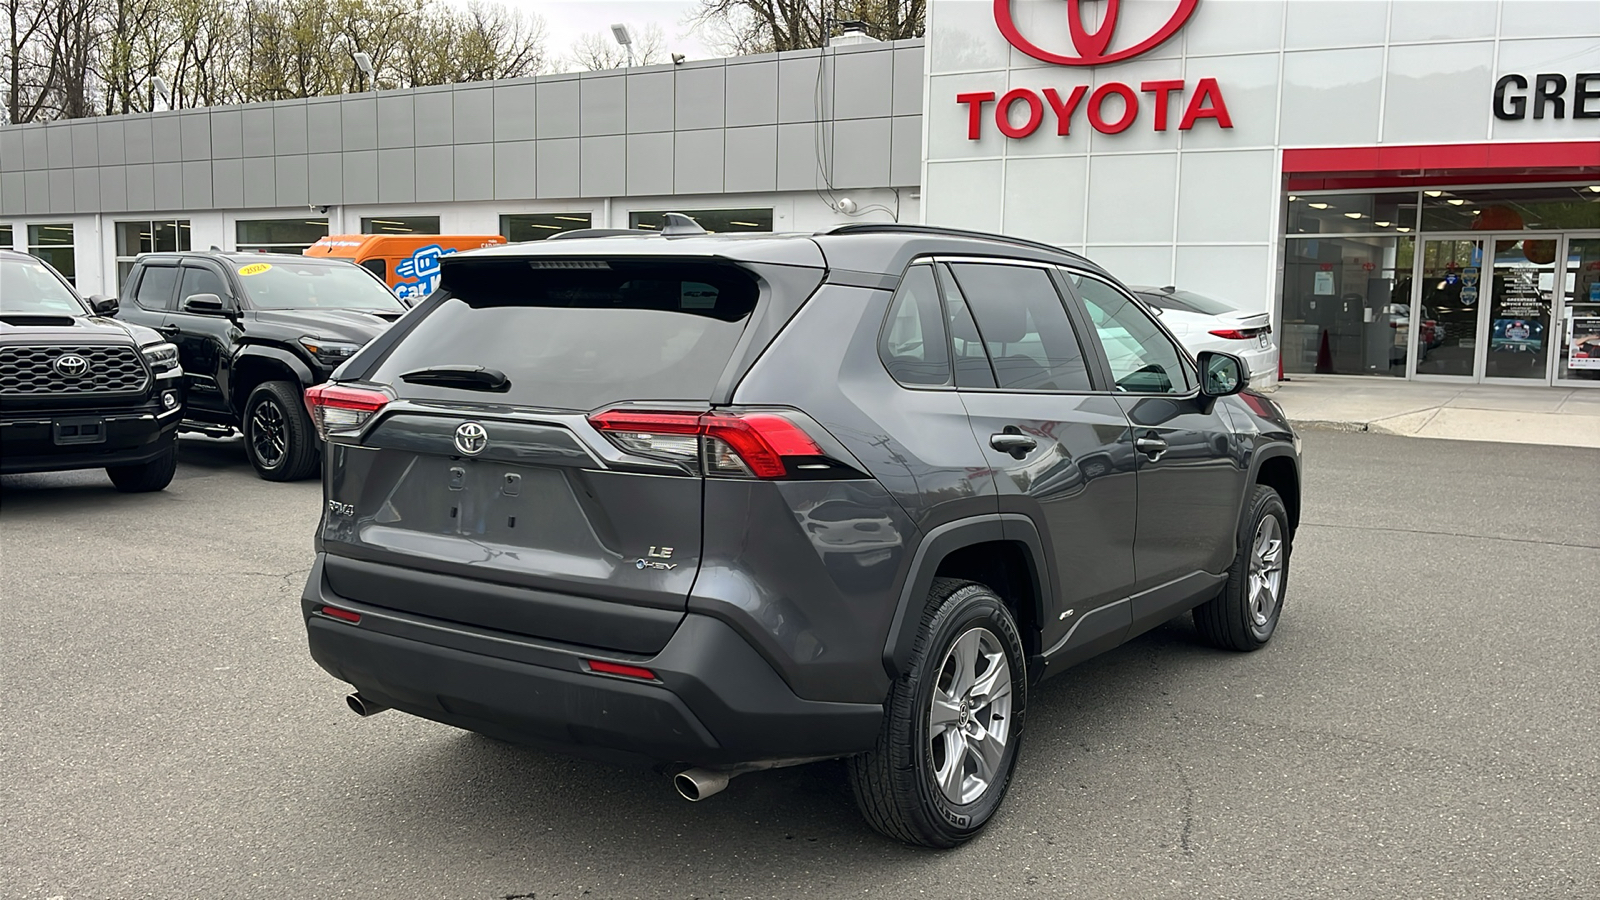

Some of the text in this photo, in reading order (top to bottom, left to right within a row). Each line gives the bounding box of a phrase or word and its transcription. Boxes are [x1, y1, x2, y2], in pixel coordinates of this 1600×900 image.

[957, 78, 1234, 140] TOYOTA
[1493, 73, 1600, 120] GRE
[244, 263, 267, 275] 2024
[648, 545, 674, 558] LE
